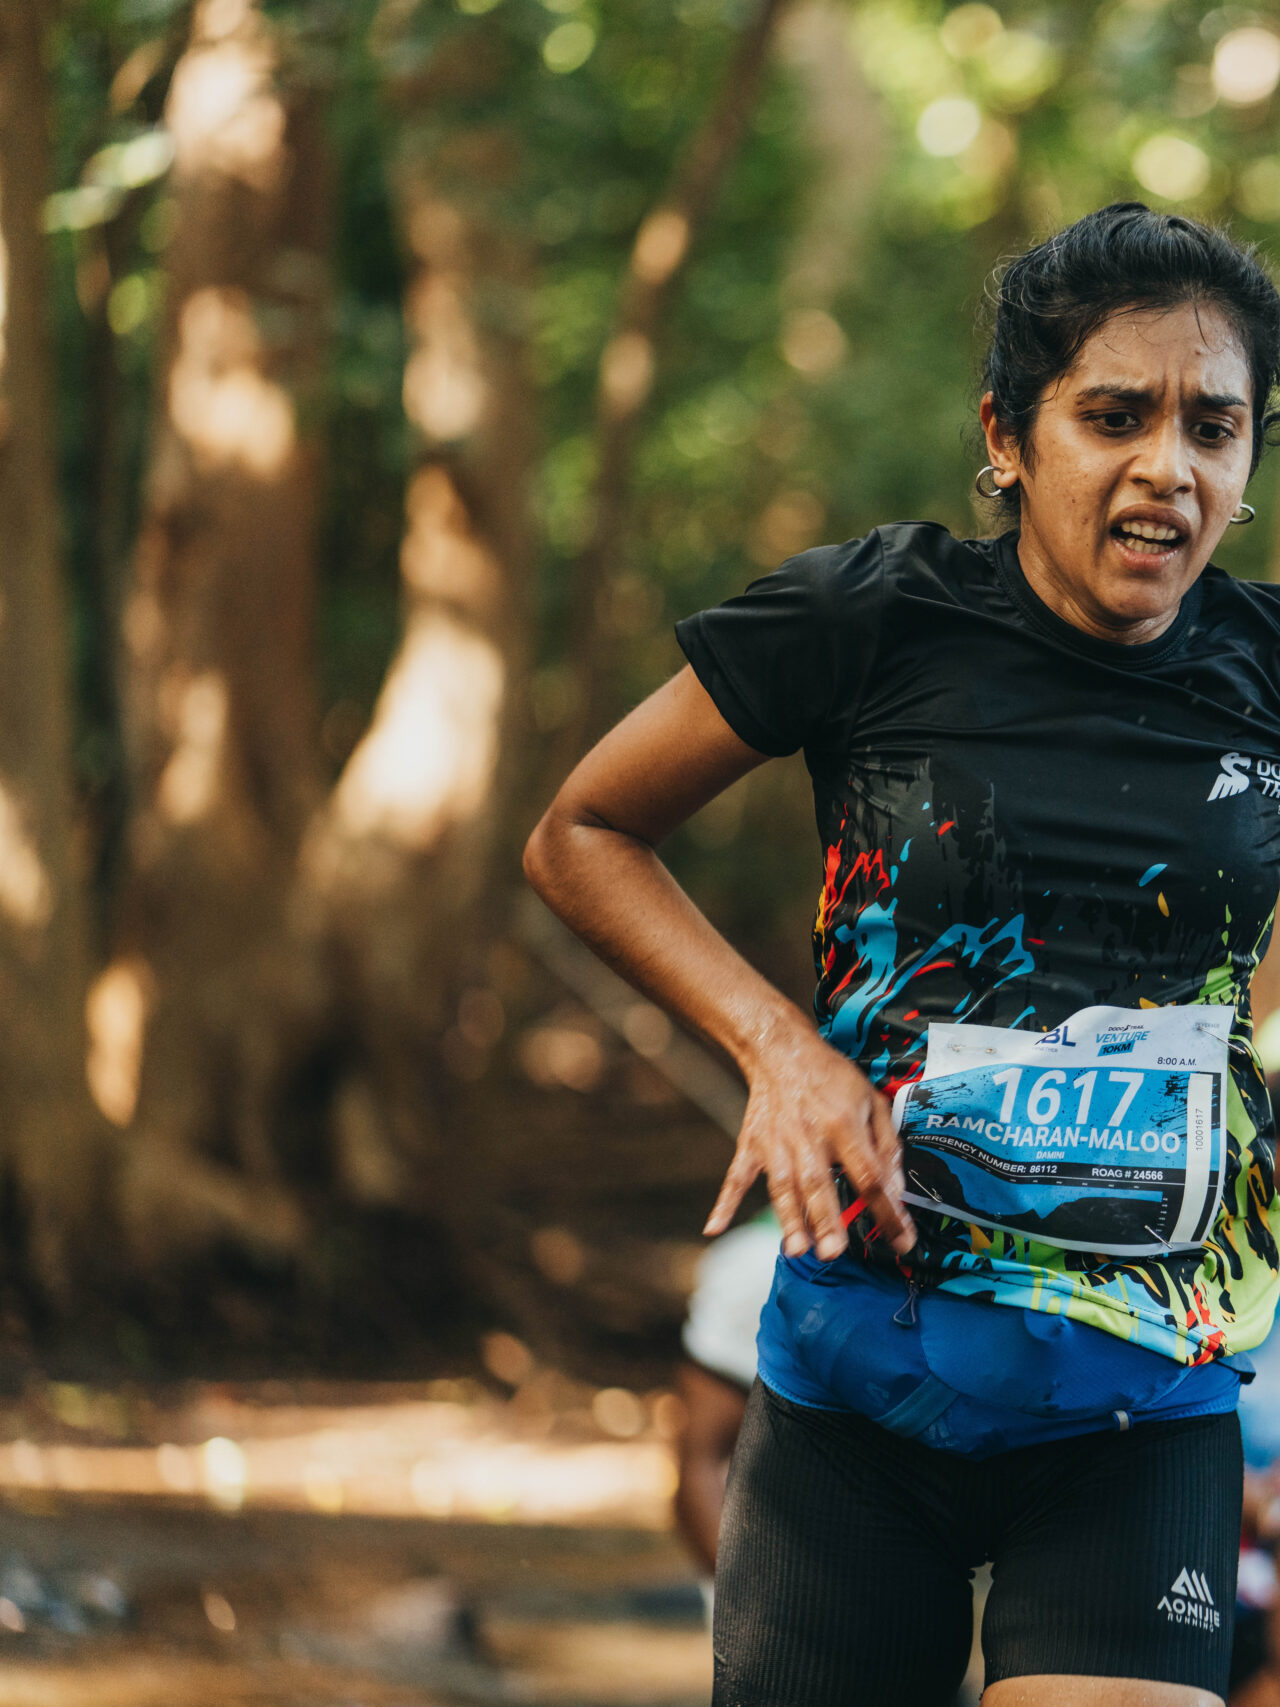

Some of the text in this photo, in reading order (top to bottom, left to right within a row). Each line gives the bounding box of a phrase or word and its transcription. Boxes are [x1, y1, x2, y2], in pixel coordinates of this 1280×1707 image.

[1095, 1030, 1151, 1044] VENTURE
[1102, 1042, 1132, 1055] 10KM
[1157, 1056, 1197, 1066] 8:00 A.M.
[992, 1067, 1145, 1127] 1617
[925, 1114, 1181, 1154] RAMCHARAN-MALOO
[1195, 1108, 1204, 1151] 10001617
[906, 1135, 977, 1154] EMERGENCY
[978, 1151, 1027, 1173] NUMBER:
[1092, 1167, 1164, 1181] ROAG # 24566
[1157, 1595, 1220, 1628] AONIJIE
[1167, 1612, 1214, 1633] RUNNING
